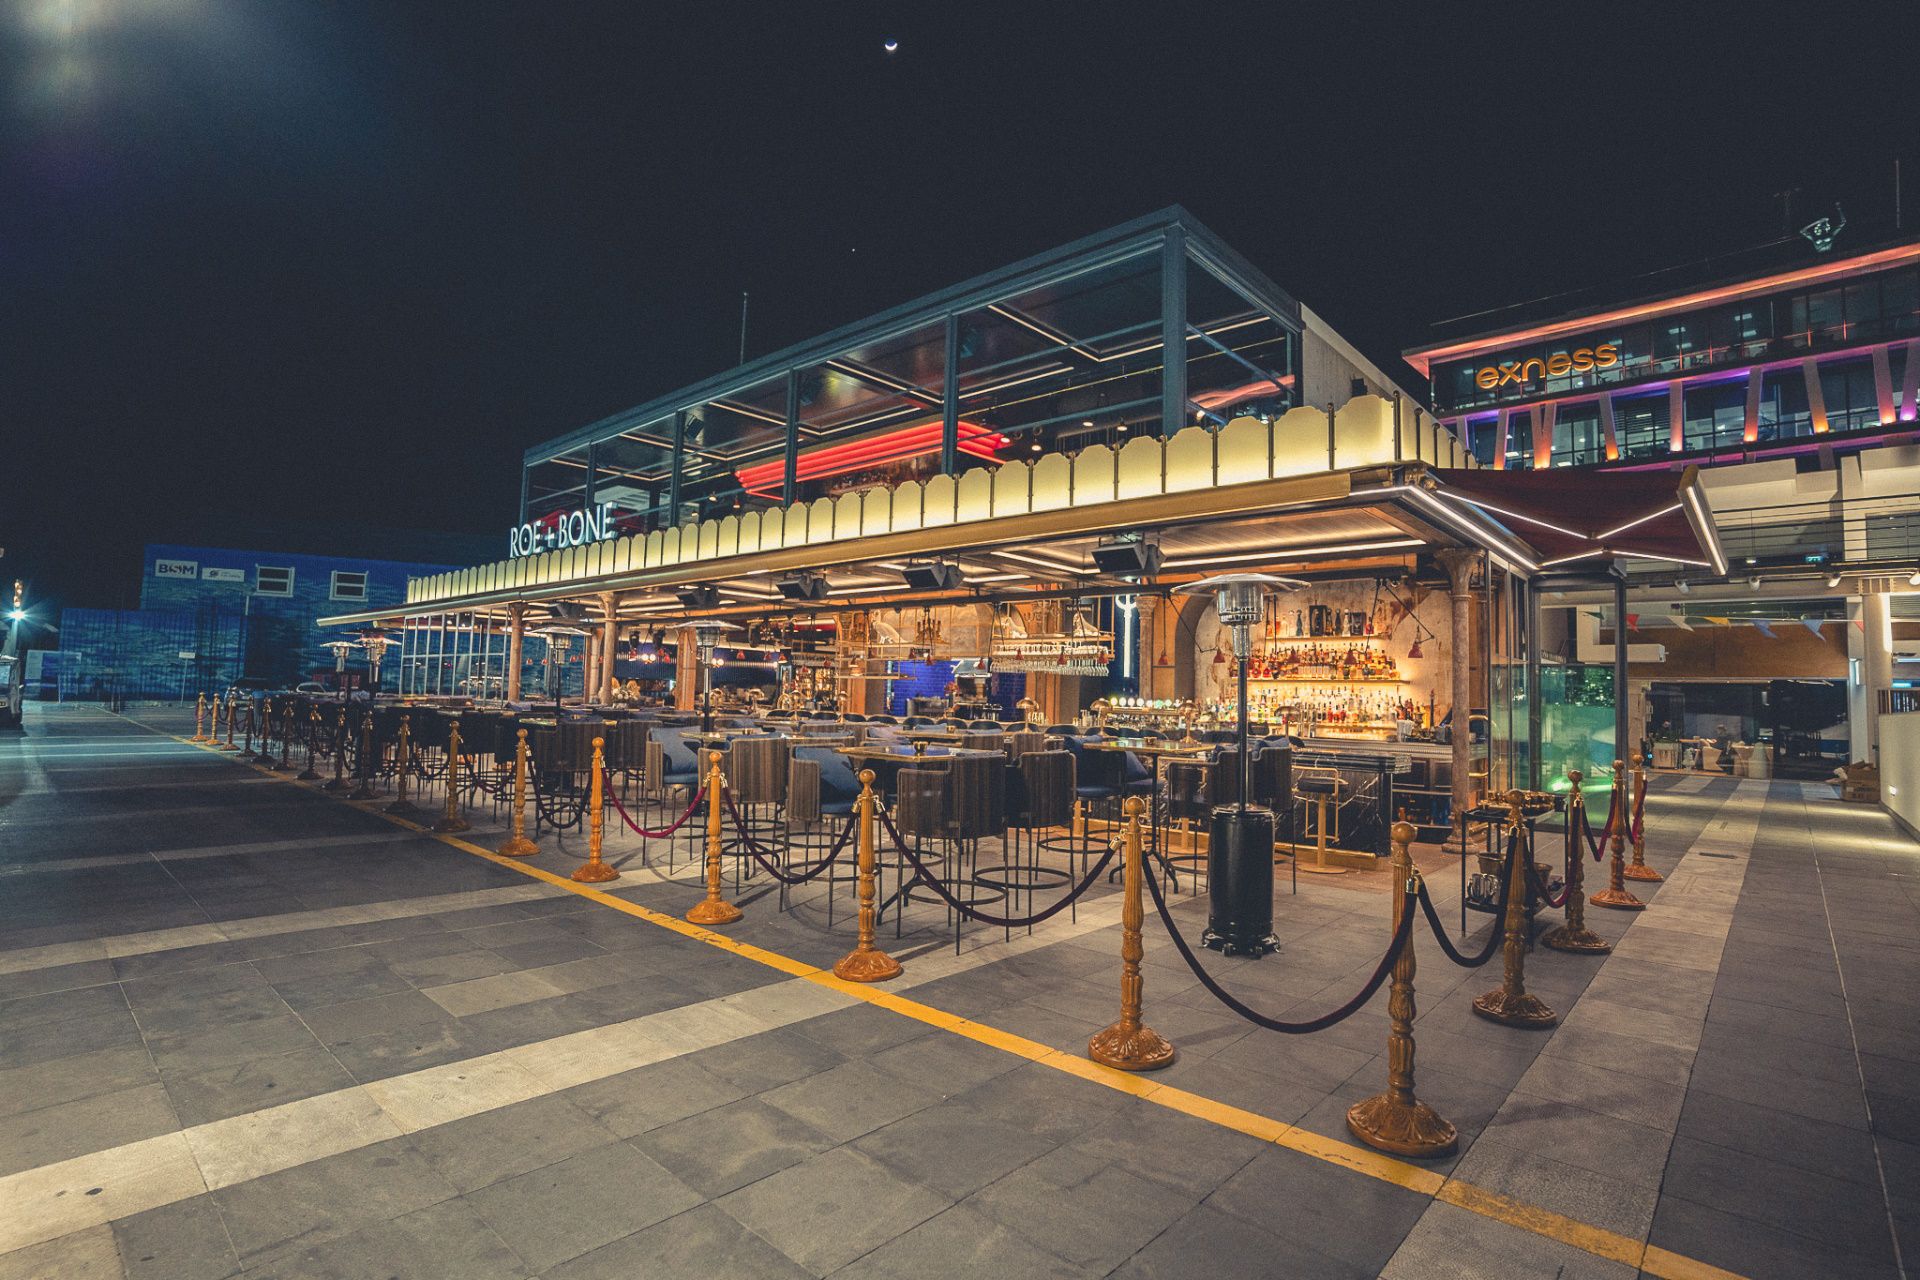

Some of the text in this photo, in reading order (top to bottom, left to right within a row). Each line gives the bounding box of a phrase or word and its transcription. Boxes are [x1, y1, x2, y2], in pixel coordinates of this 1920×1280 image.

[1476, 344, 1617, 389] exness
[510, 501, 617, 558] ROE + BONE
